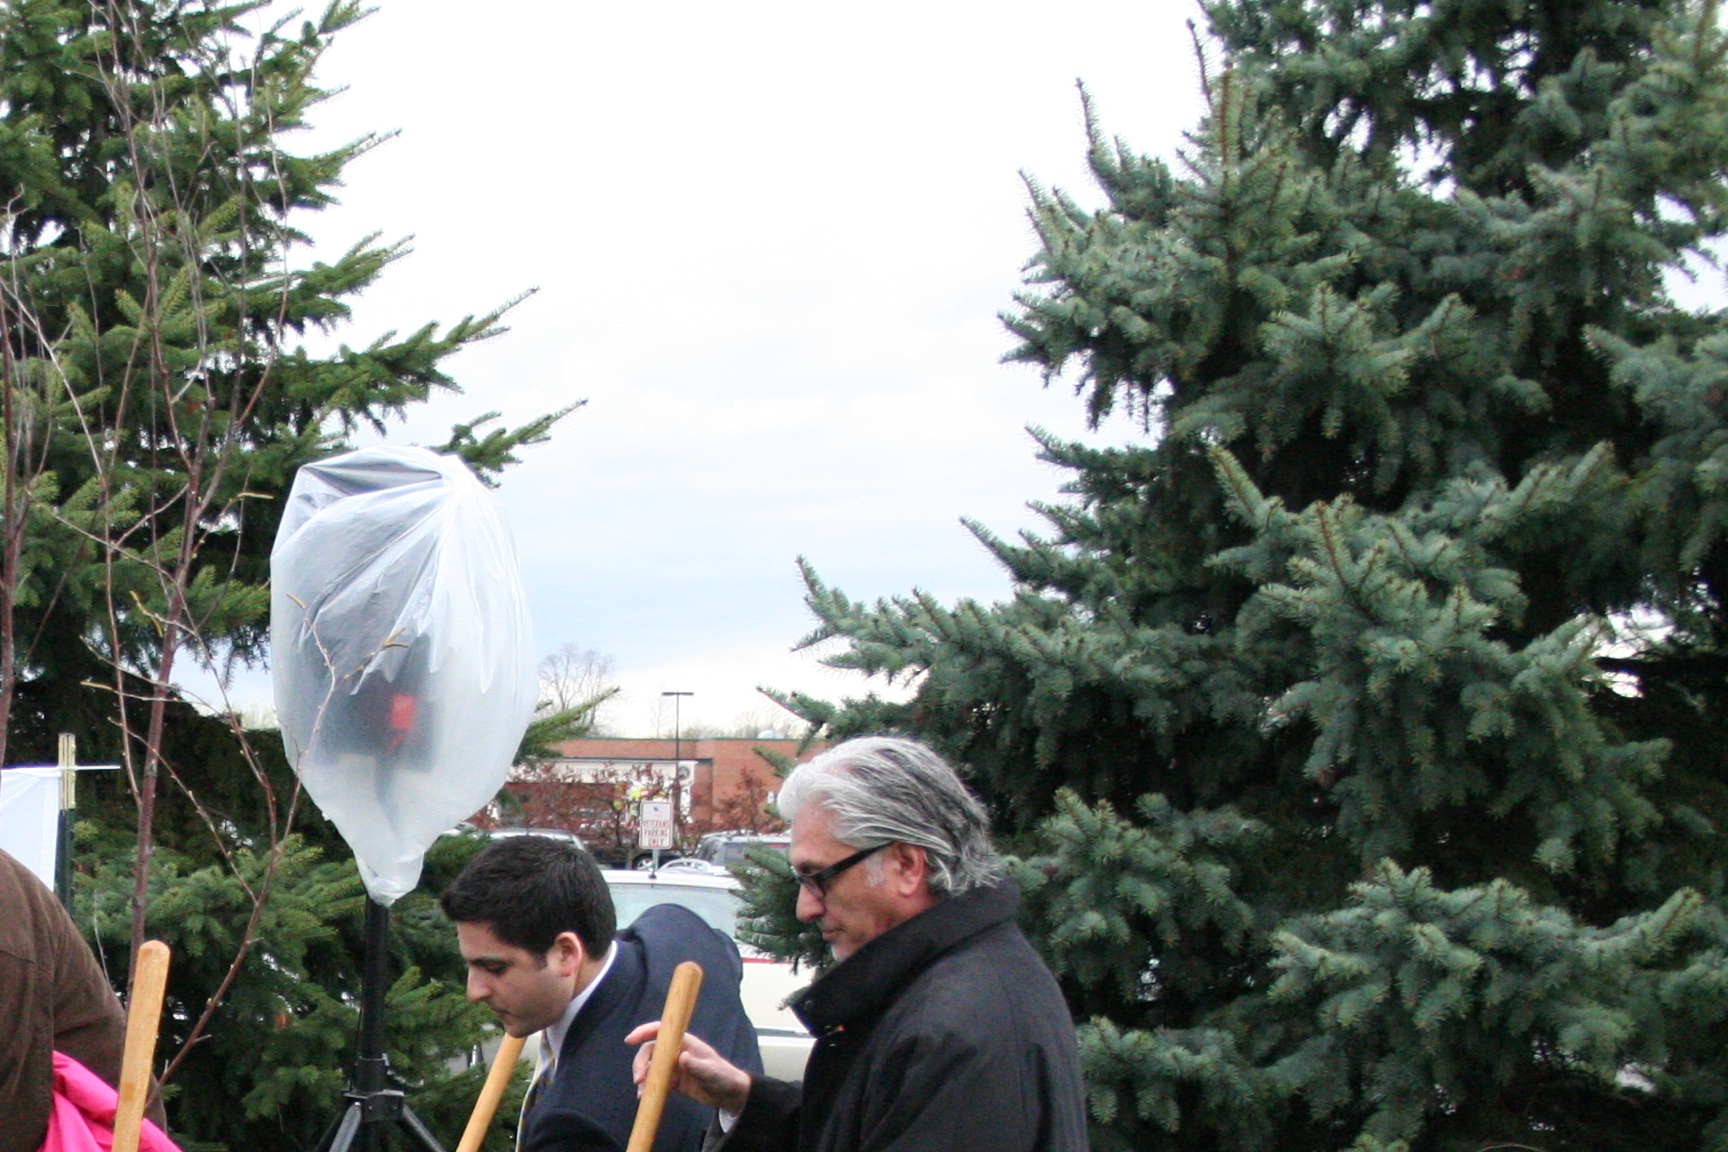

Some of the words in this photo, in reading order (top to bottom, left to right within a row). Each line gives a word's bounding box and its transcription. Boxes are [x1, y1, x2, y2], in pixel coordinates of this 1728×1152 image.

[642, 820, 670, 829] VETERANS
[644, 829, 668, 838] PARKING
[648, 838, 664, 847] ONLY
